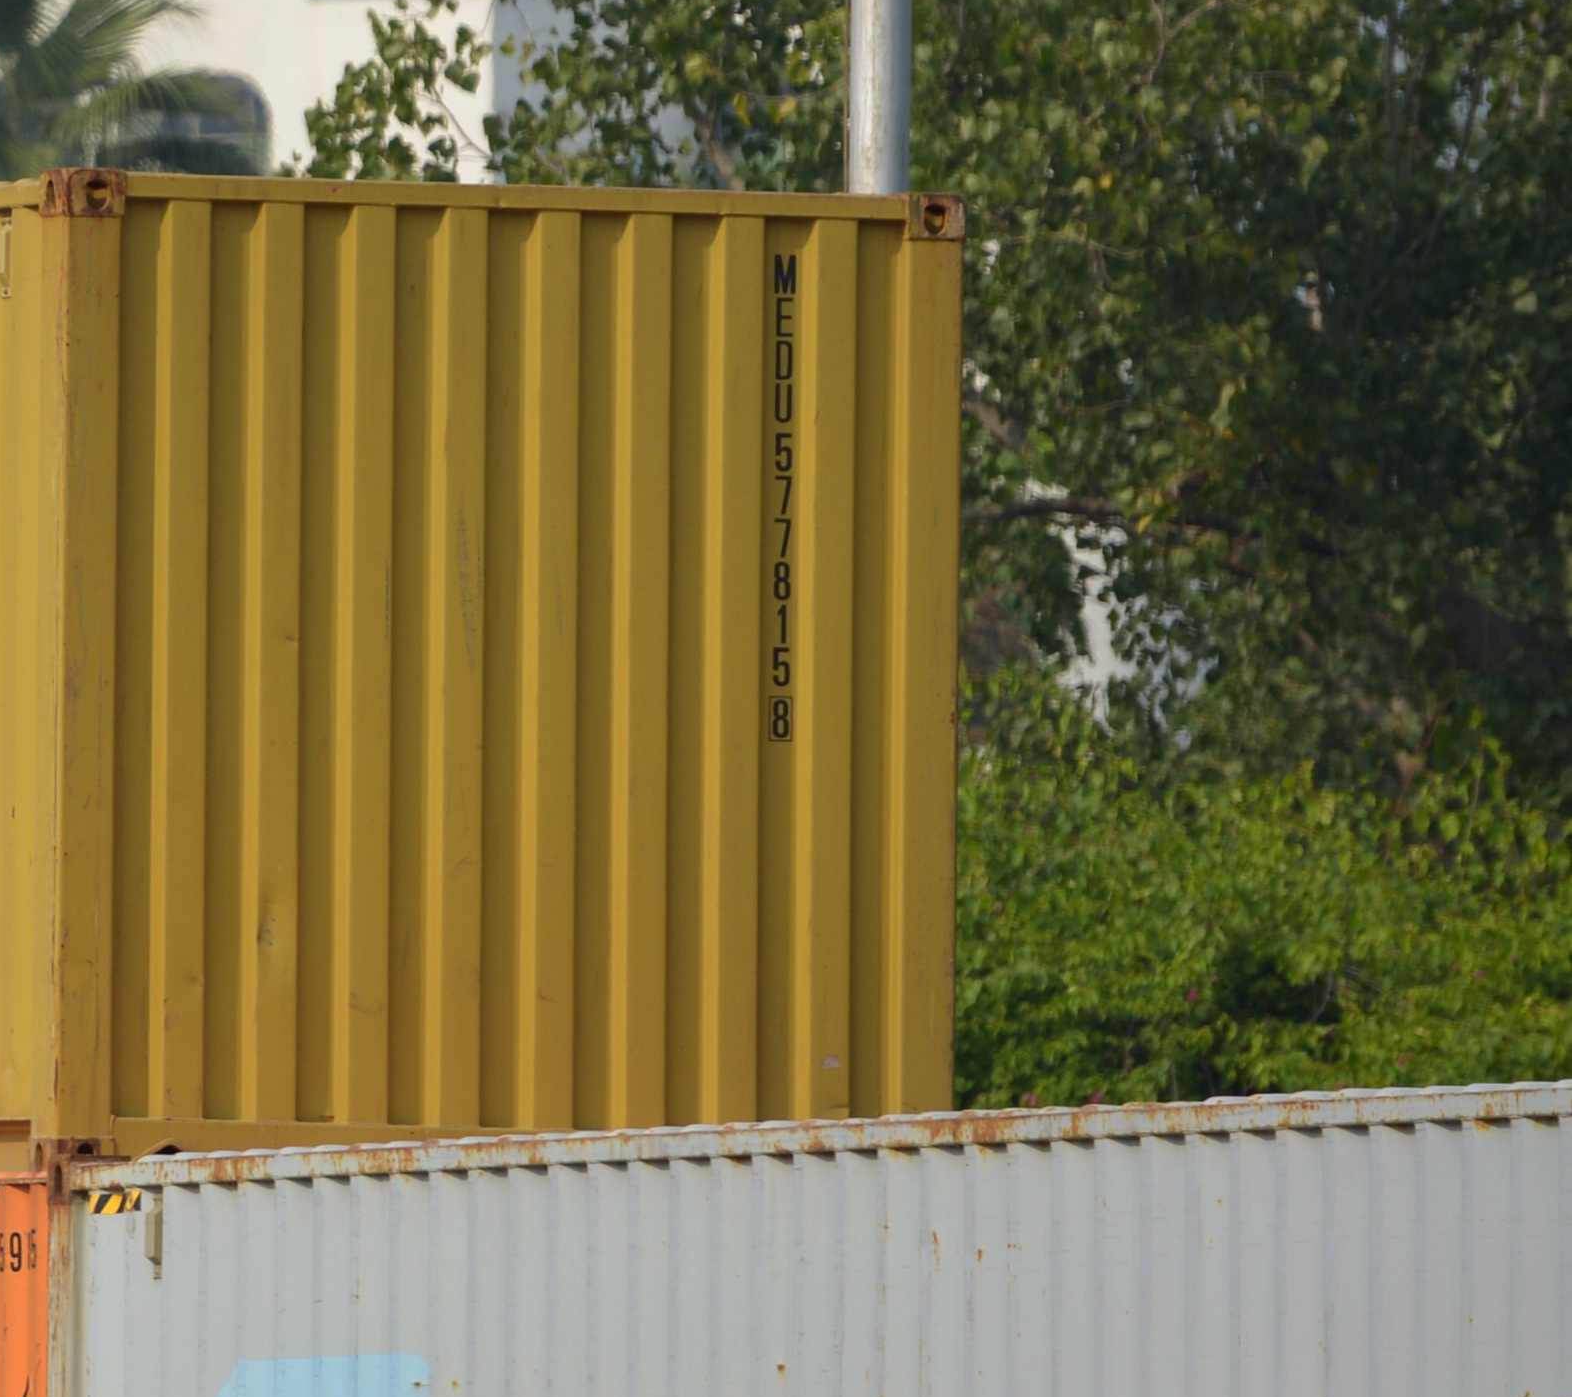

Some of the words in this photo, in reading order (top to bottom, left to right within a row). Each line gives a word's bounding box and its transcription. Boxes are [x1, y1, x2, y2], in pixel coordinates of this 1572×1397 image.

[772, 254, 797, 423] MEDU
[771, 433, 793, 687] 577815
[769, 696, 793, 742] 8
